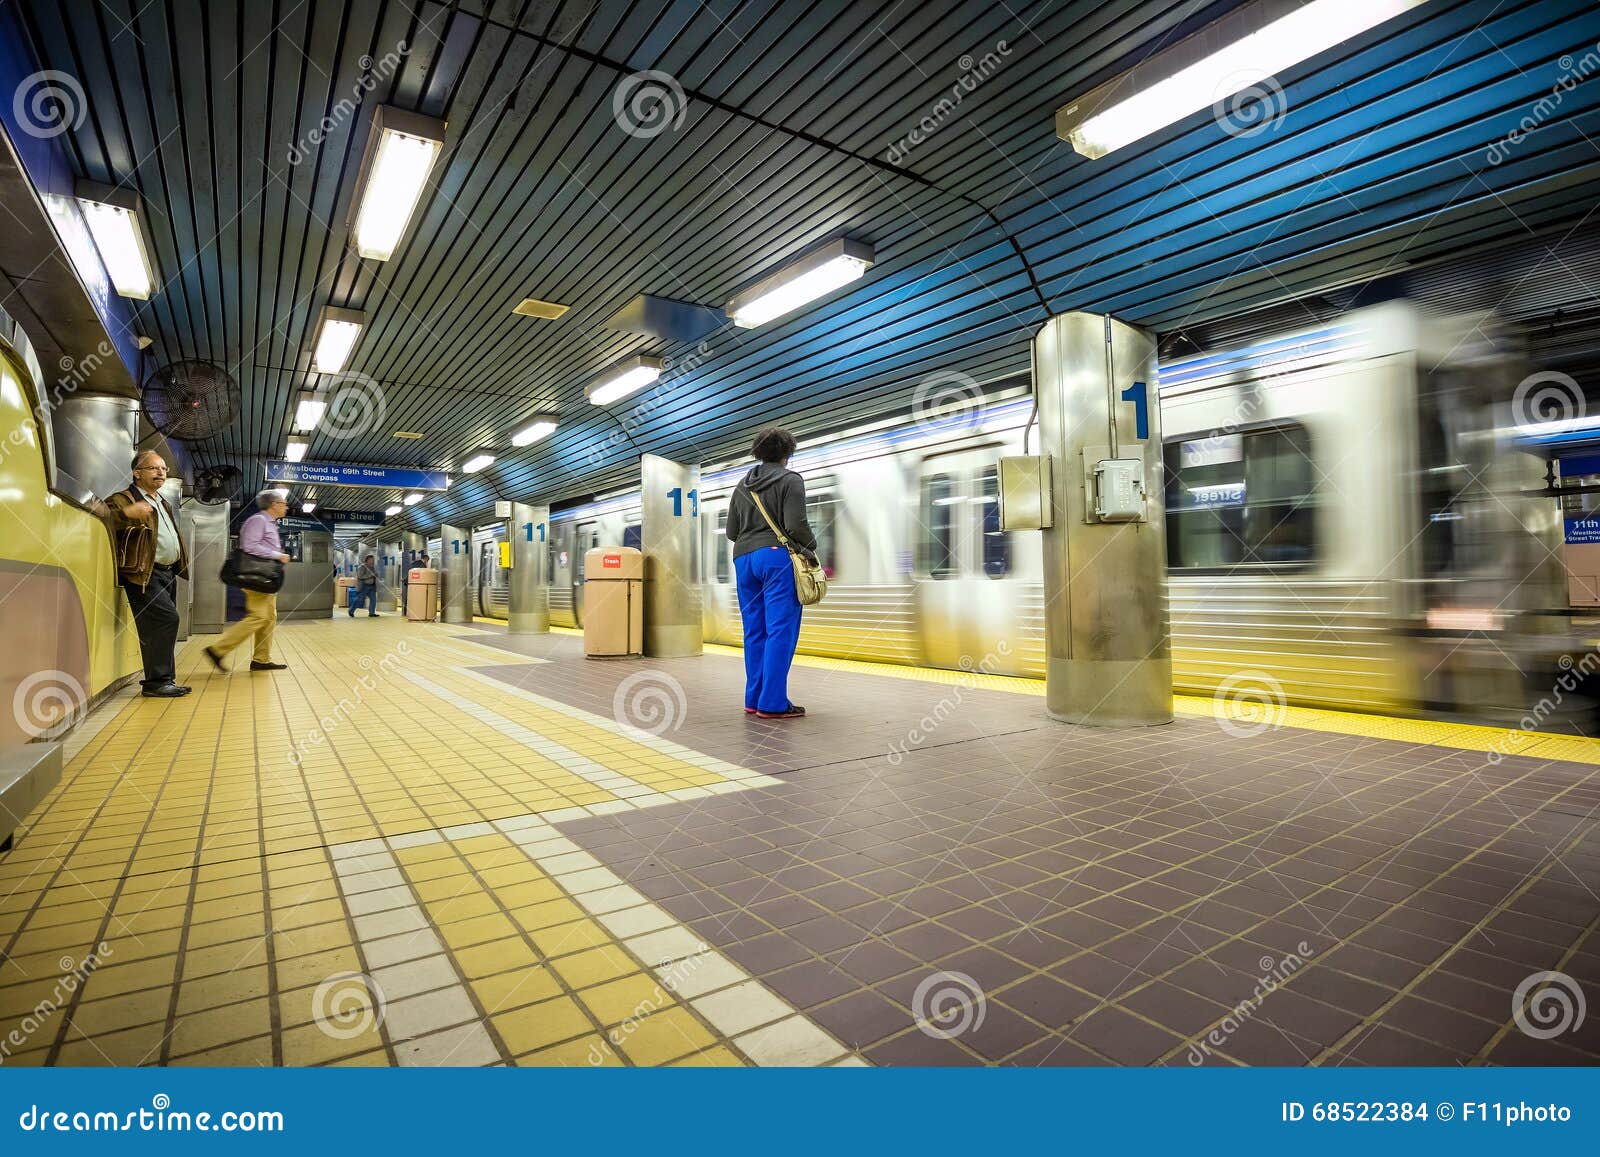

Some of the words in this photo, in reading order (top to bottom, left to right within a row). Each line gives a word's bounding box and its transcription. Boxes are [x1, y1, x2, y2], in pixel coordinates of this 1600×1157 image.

[284, 464, 328, 474] Westbound
[331, 466, 340, 474] to
[342, 467, 360, 476] 69th
[363, 469, 385, 477] Street
[302, 473, 339, 482] Overpass
[666, 487, 698, 518] 11
[1573, 519, 1599, 528] 11th
[522, 522, 545, 543] 11
[451, 539, 469, 554] 11
